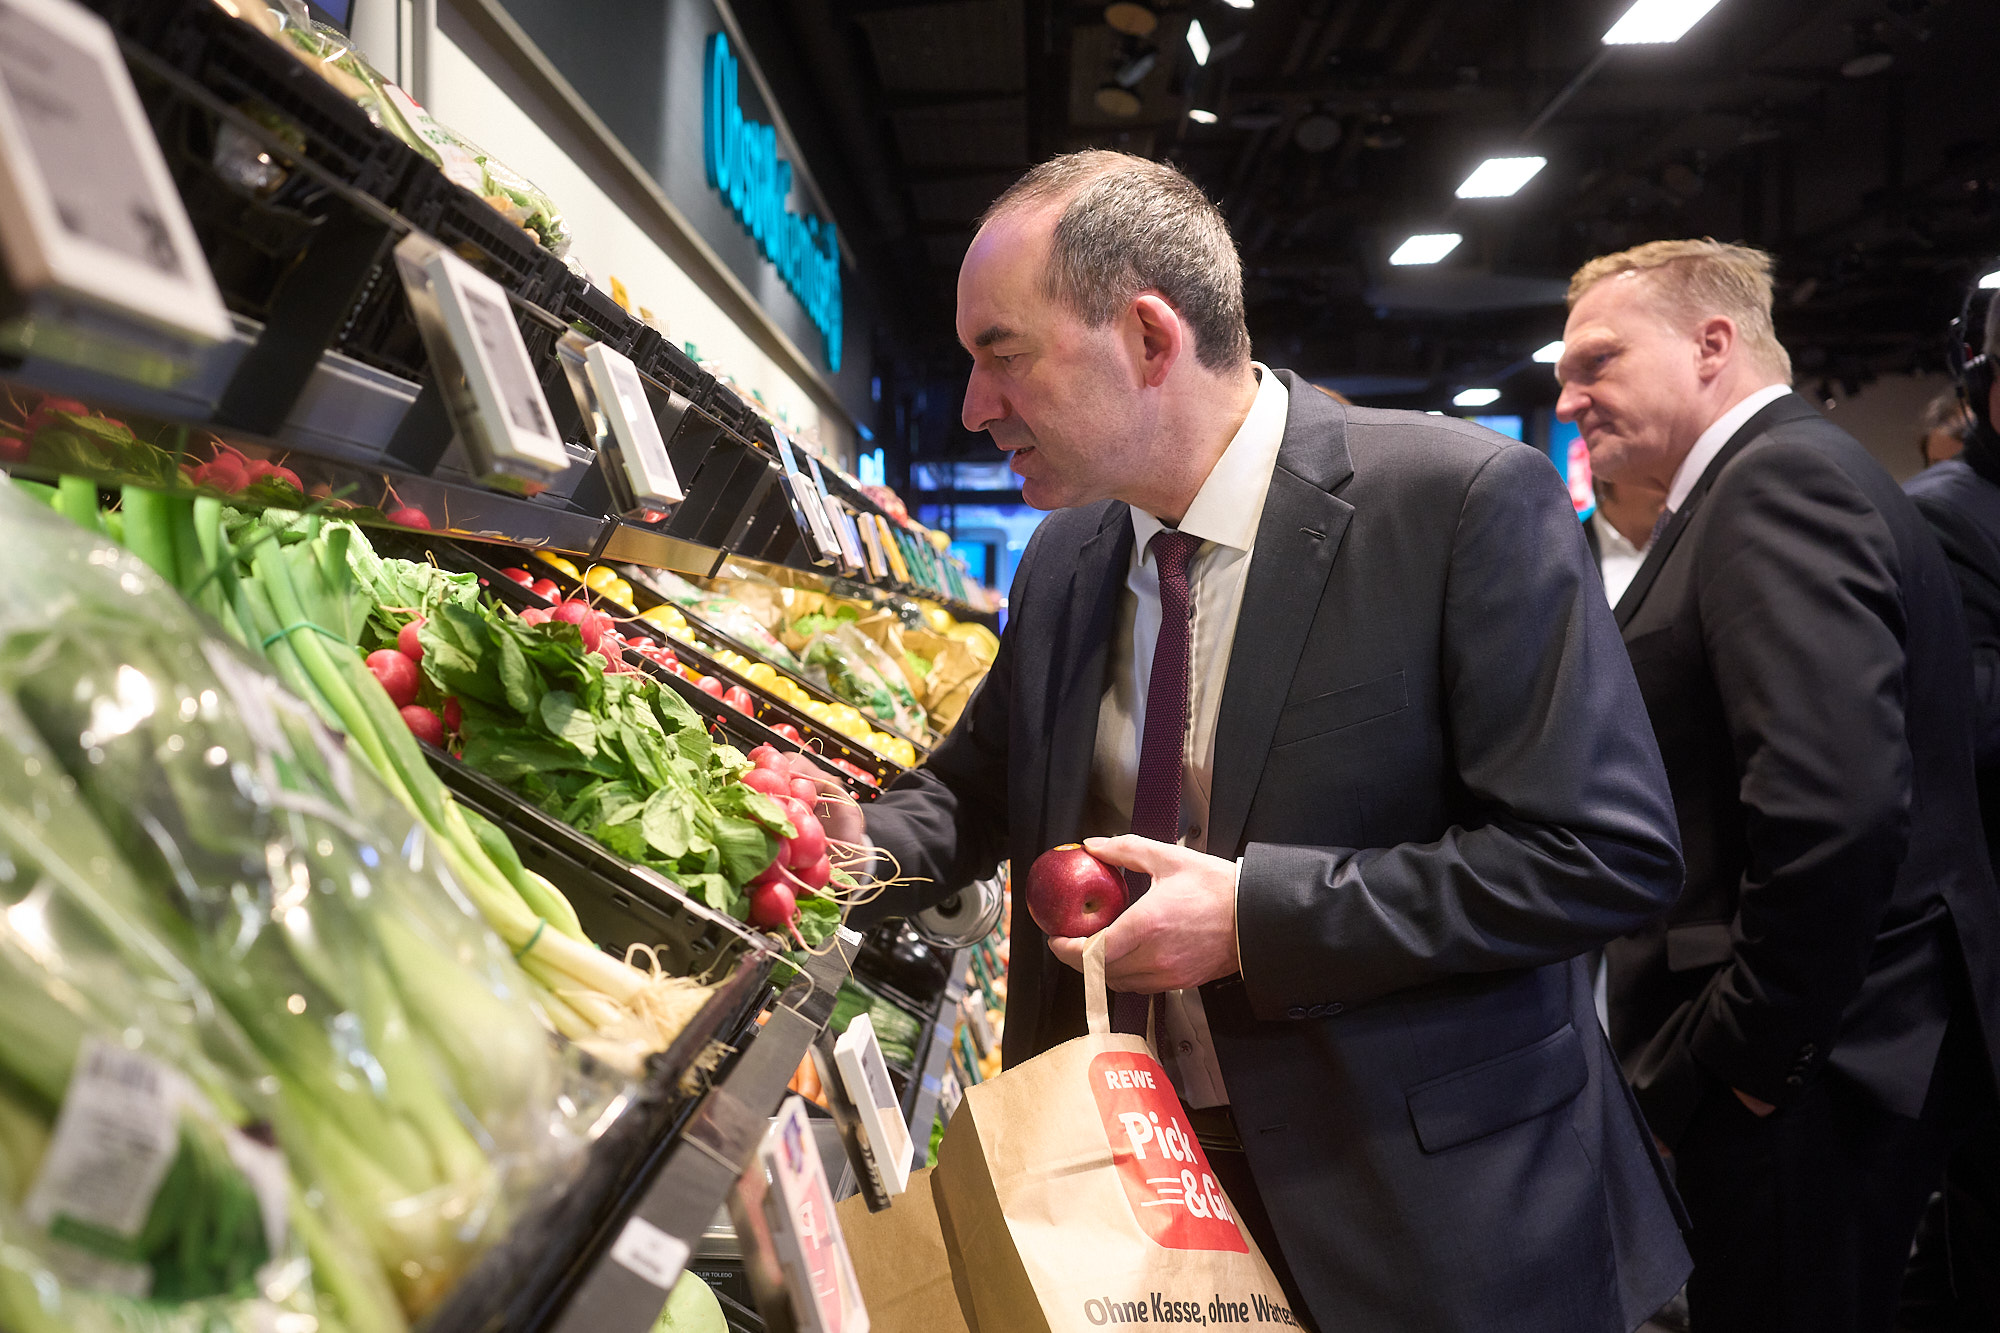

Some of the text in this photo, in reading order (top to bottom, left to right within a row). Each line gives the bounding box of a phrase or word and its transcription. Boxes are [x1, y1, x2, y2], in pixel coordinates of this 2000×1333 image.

[1105, 1070, 1156, 1090] REWE
[1118, 1111, 1198, 1165] Pick
[1083, 1292, 1300, 1329] Ohne Kasse, ohne Warte
